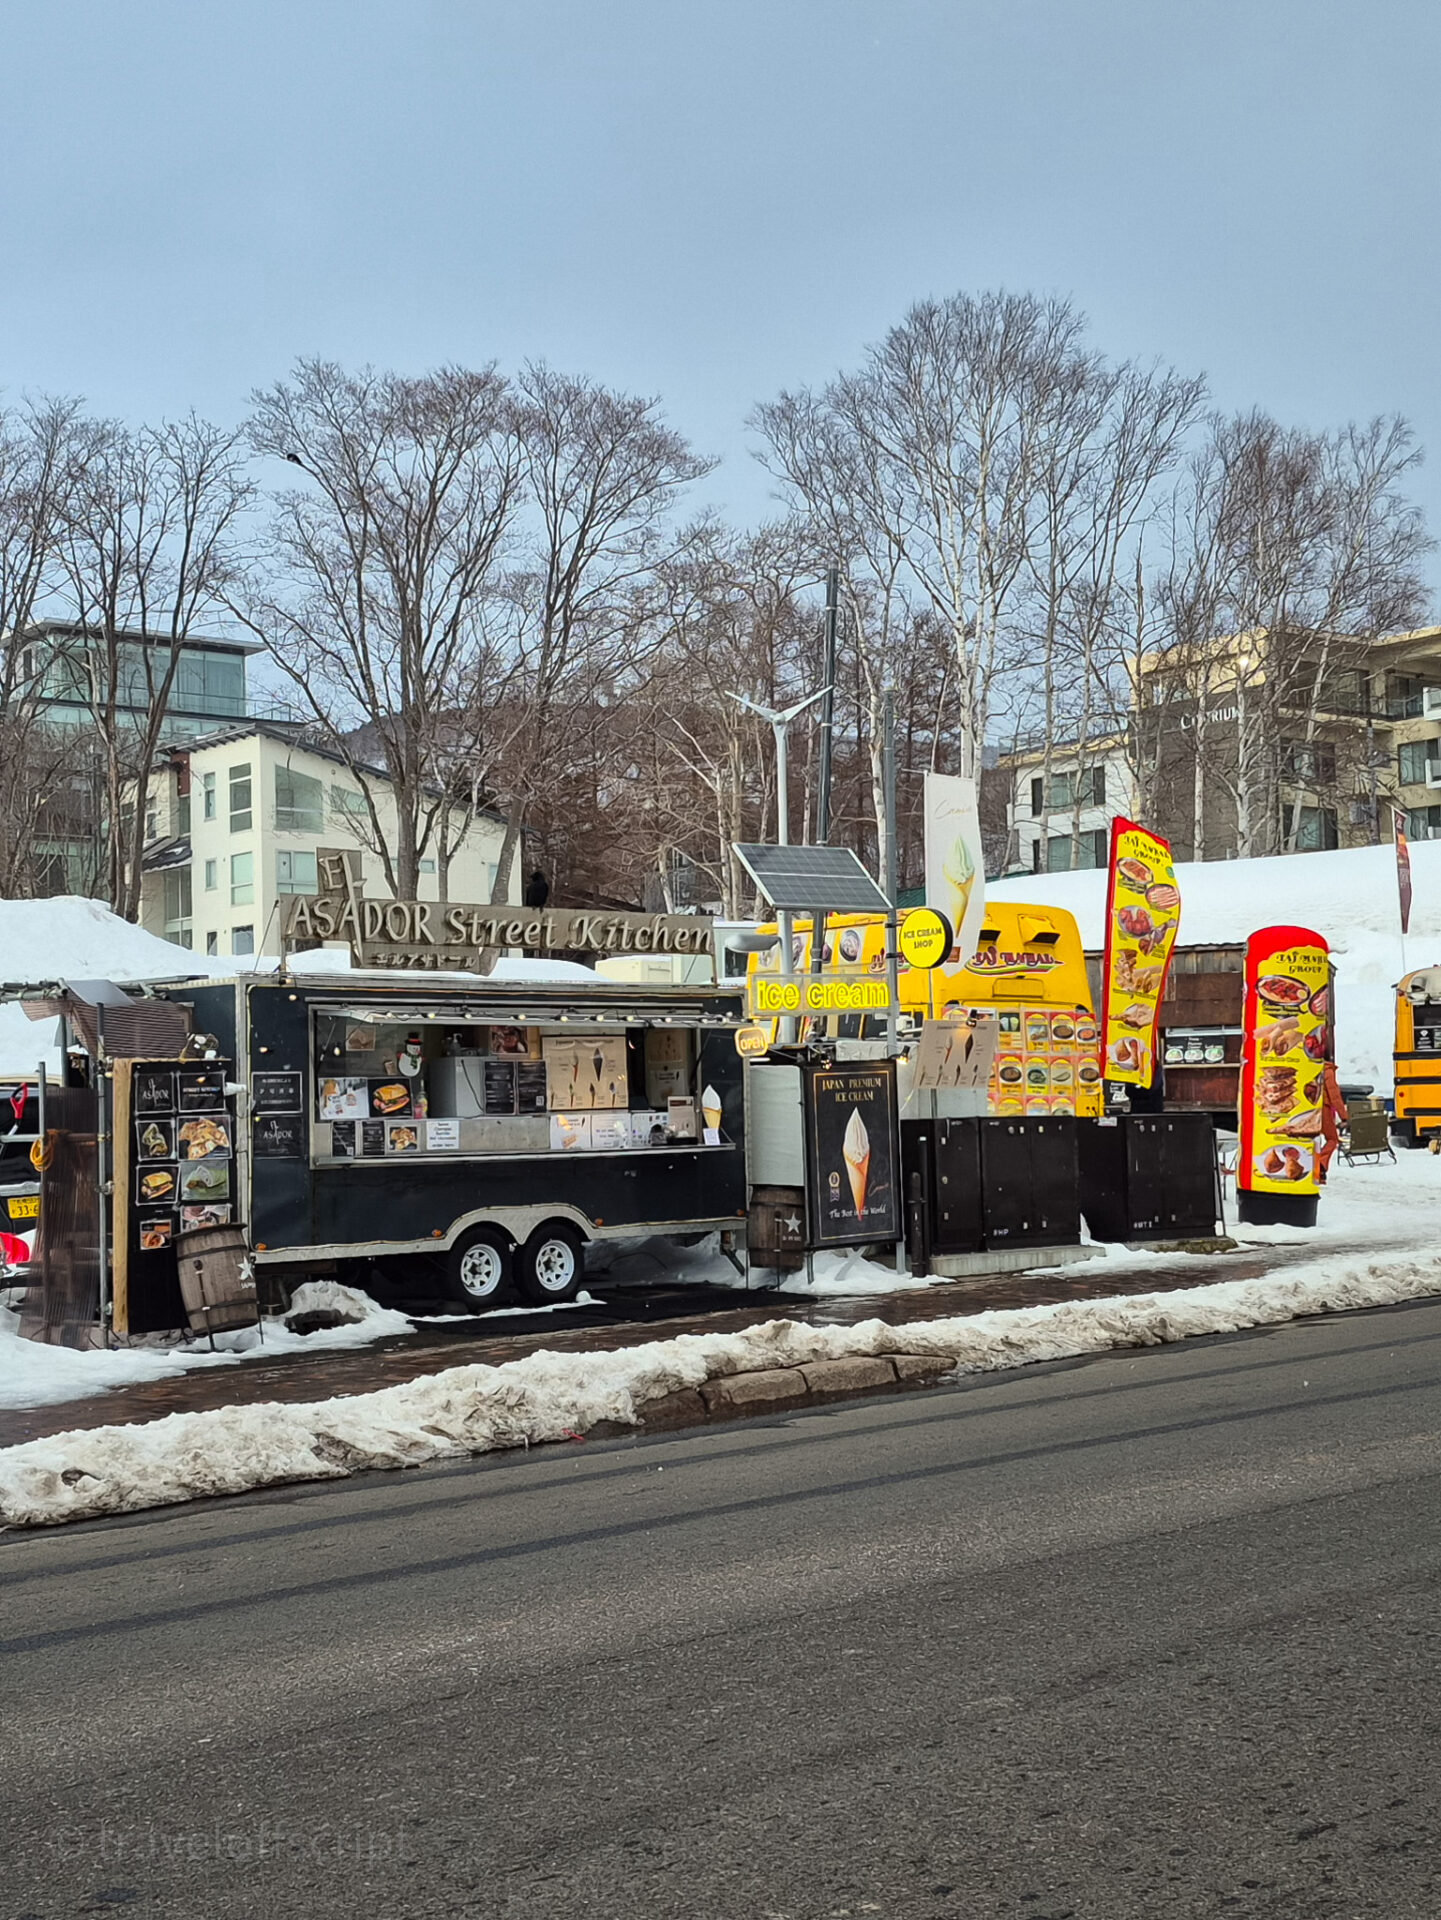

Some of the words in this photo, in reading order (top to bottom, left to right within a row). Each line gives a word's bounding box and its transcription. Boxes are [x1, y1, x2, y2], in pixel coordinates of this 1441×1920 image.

[286, 894, 436, 960] ASADOR
[448, 907, 558, 948] Street
[569, 915, 713, 954] Kitchen
[903, 930, 915, 939] ICE
[916, 925, 943, 938] CREAM
[913, 939, 934, 950] SHOP
[1276, 951, 1299, 964] TAJ
[1300, 954, 1328, 965] MAHA
[757, 980, 800, 1010] ice
[807, 982, 890, 1009] cream
[740, 1037, 765, 1050] OPEN
[822, 1079, 844, 1091] JAPAN
[849, 1077, 881, 1089] PREMIUM
[835, 1092, 847, 1102] ICE
[848, 1090, 873, 1101] CREAM
